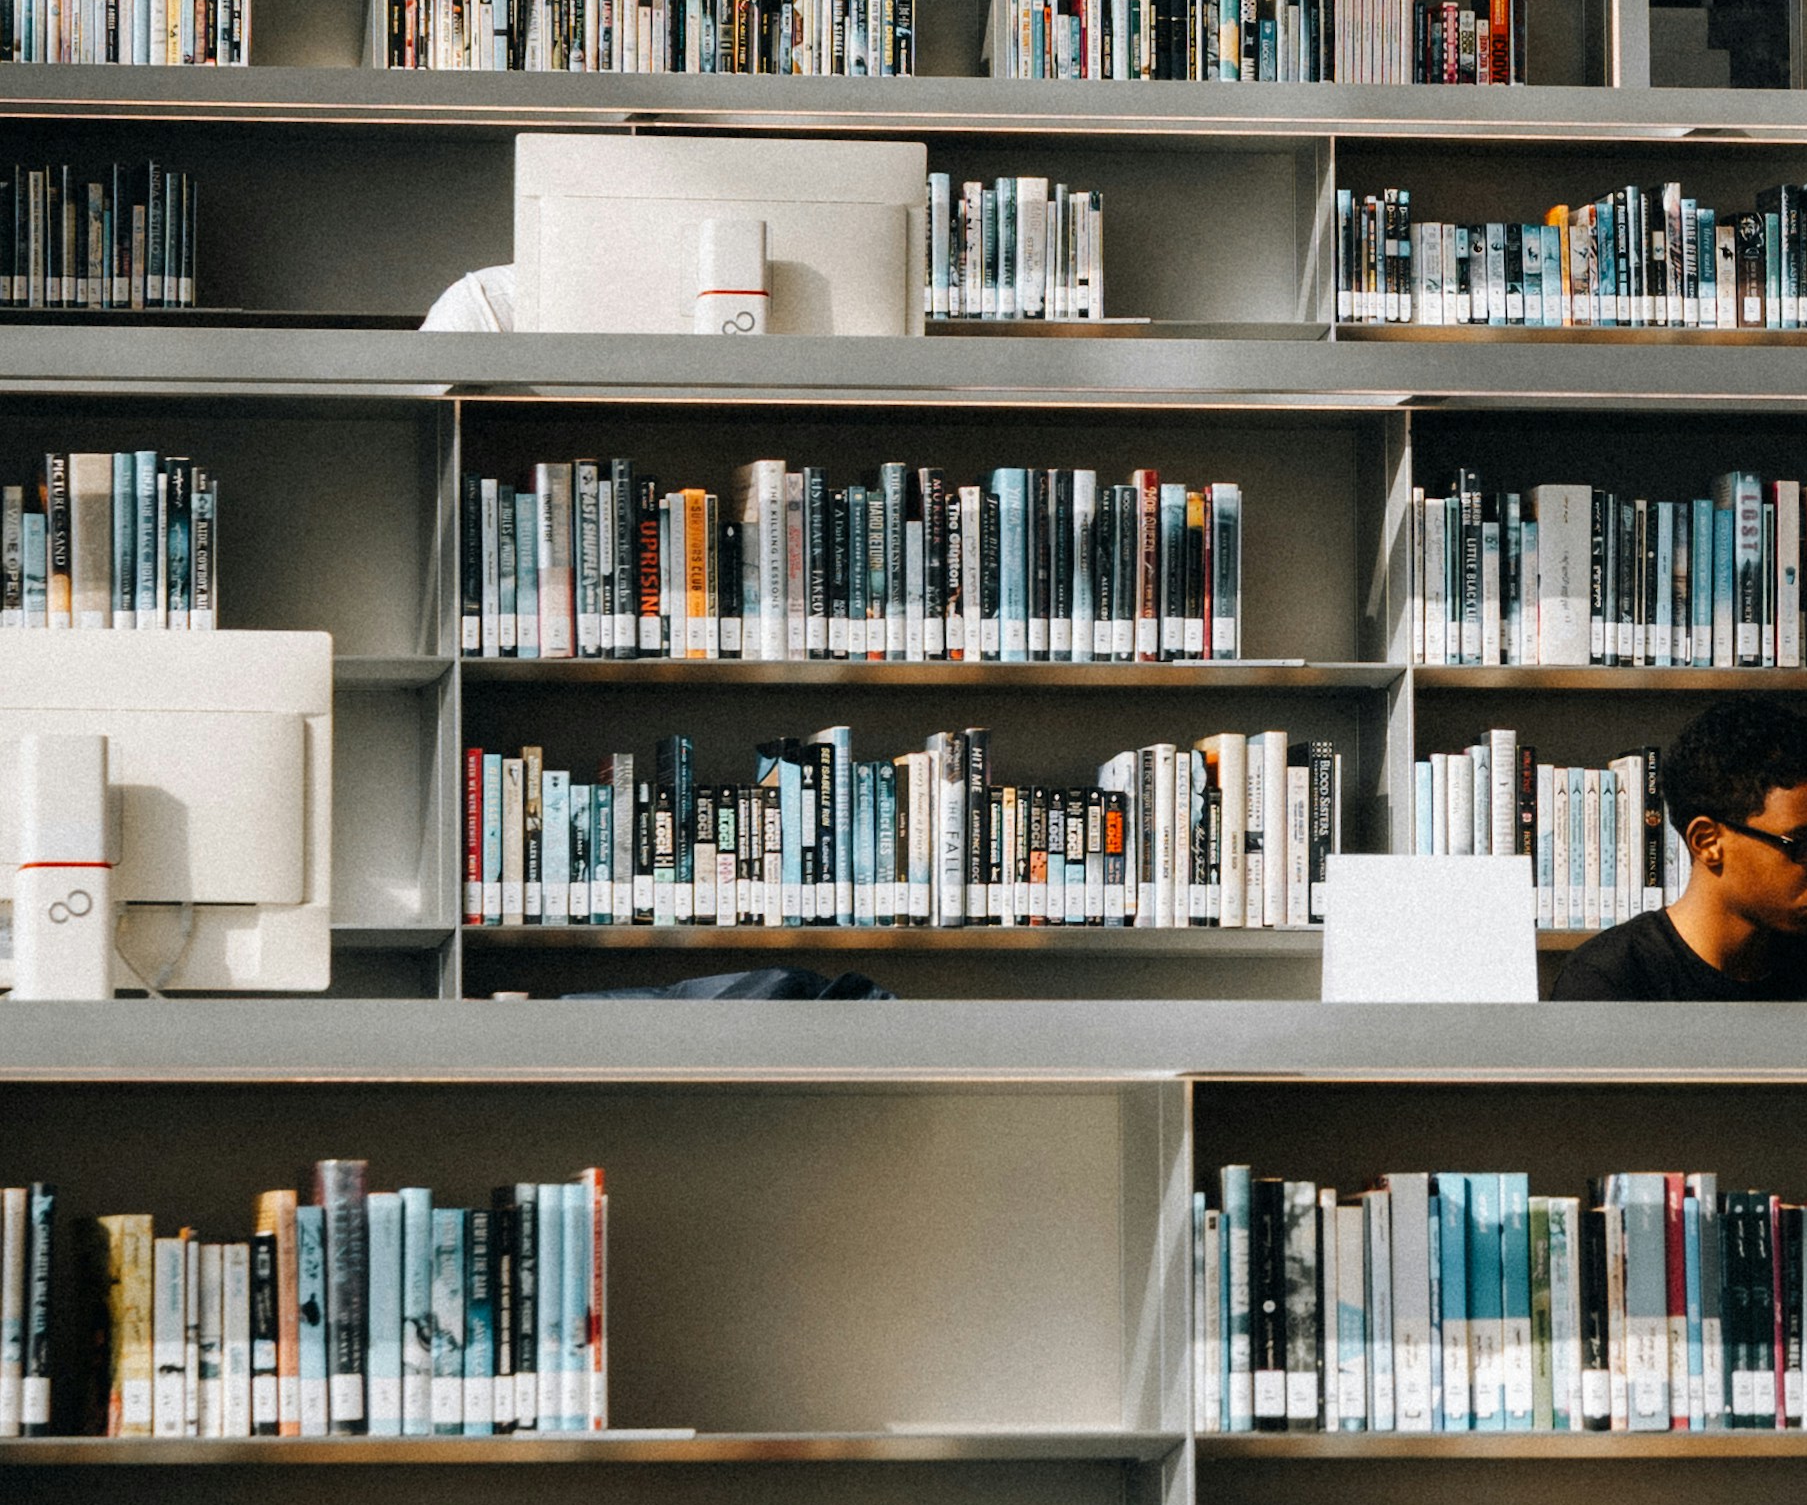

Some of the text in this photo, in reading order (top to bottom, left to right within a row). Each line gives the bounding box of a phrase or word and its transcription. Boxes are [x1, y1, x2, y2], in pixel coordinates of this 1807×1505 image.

[885, 25, 893, 65] DRIVER
[54, 459, 66, 565] PICTURE SAND
[770, 485, 778, 506] THE
[811, 478, 822, 508] LISA
[1461, 491, 1481, 526] SHARON BOLTON
[543, 494, 552, 543] UNDER FIRE
[835, 509, 845, 543] A Dark
[869, 501, 883, 571] HARD RETURN
[948, 503, 959, 531] The
[582, 523, 598, 578] SHUFFLE
[1466, 538, 1478, 605] LITTLE BLACK
[691, 566, 702, 591] CLUB
[771, 559, 779, 609] LESSONS
[821, 748, 830, 764] SEE
[1318, 760, 1331, 835] BLOOD SISTERS
[1648, 772, 1657, 794] BOND
[697, 798, 707, 840] BLOCK
[718, 808, 729, 851] BLOCK
[765, 808, 775, 851] BLOCK
[822, 809, 830, 827] RUN
[972, 747, 982, 884] HIT ME LAWRENCE BLOCK
[1031, 807, 1041, 849] BLOCK
[1049, 810, 1058, 852] BLOCK
[880, 831, 892, 855] LIES
[945, 800, 959, 875] THE FALL
[1067, 818, 1077, 860] BLOCK
